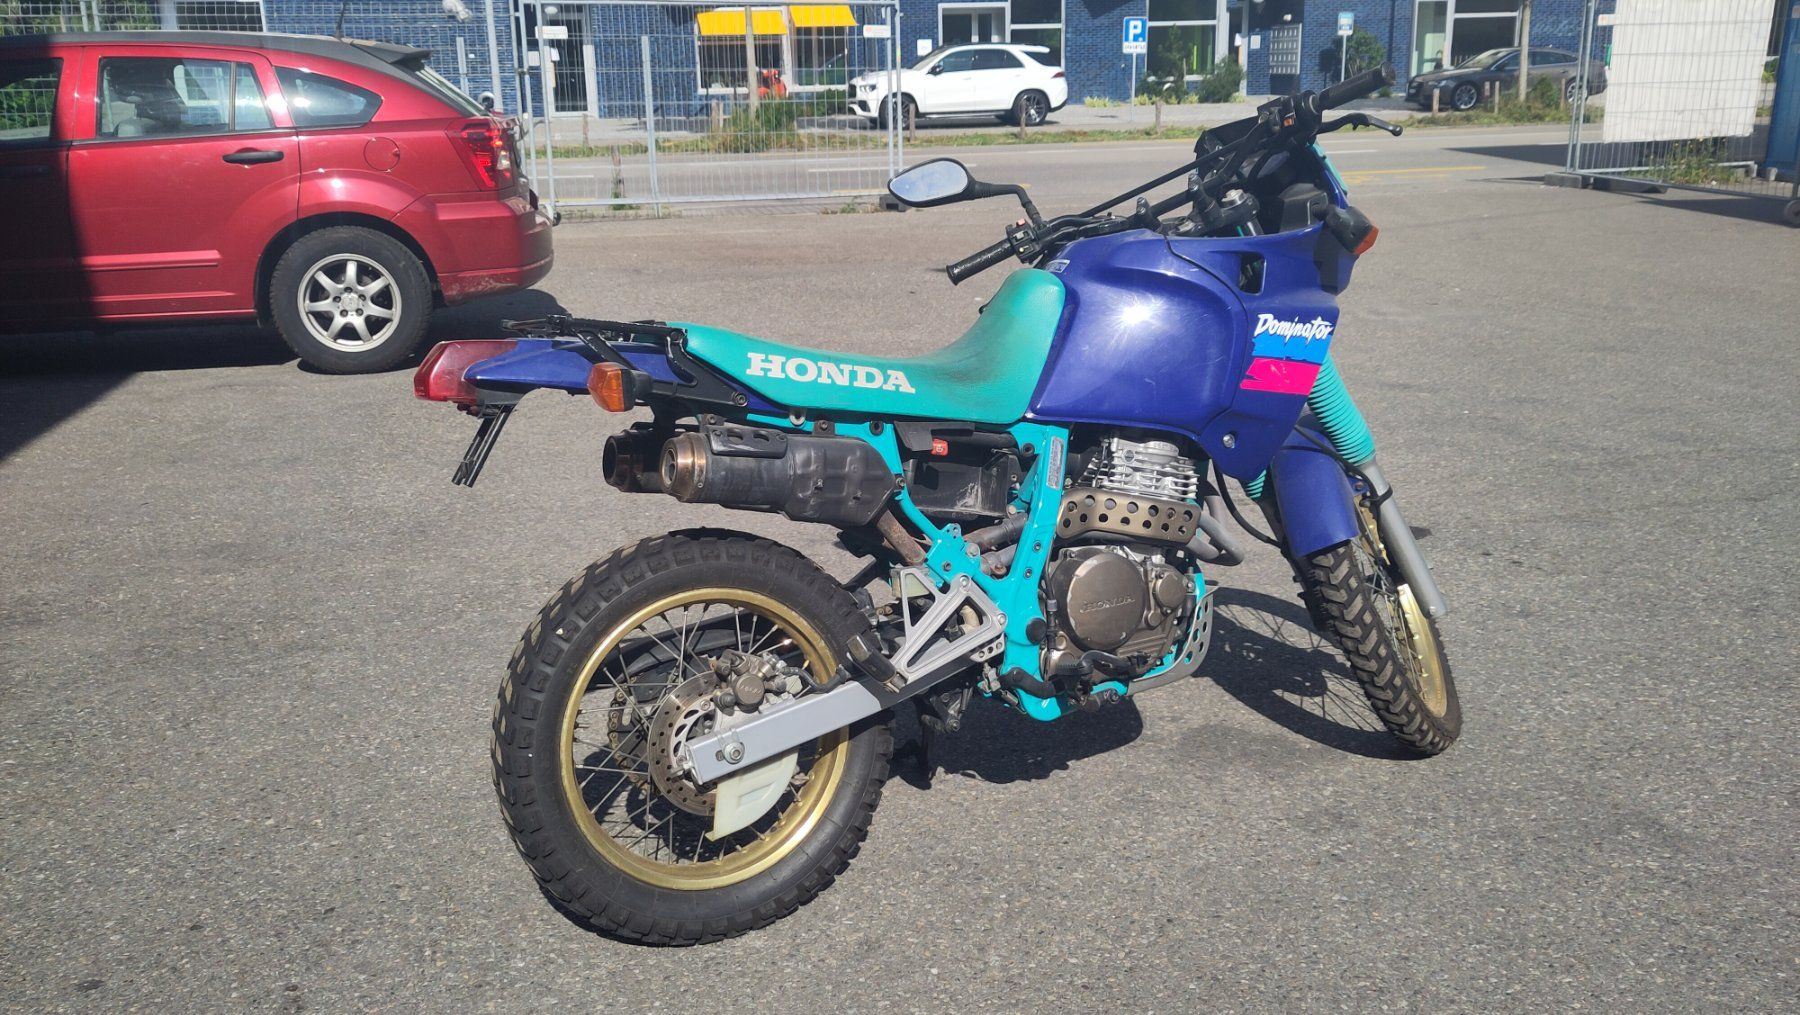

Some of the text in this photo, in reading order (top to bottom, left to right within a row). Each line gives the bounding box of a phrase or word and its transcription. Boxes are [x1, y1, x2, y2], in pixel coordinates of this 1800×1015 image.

[1129, 20, 1142, 42] P
[1254, 313, 1333, 344] Dominator
[746, 352, 916, 394] HONDA
[1080, 595, 1136, 613] HONDA
